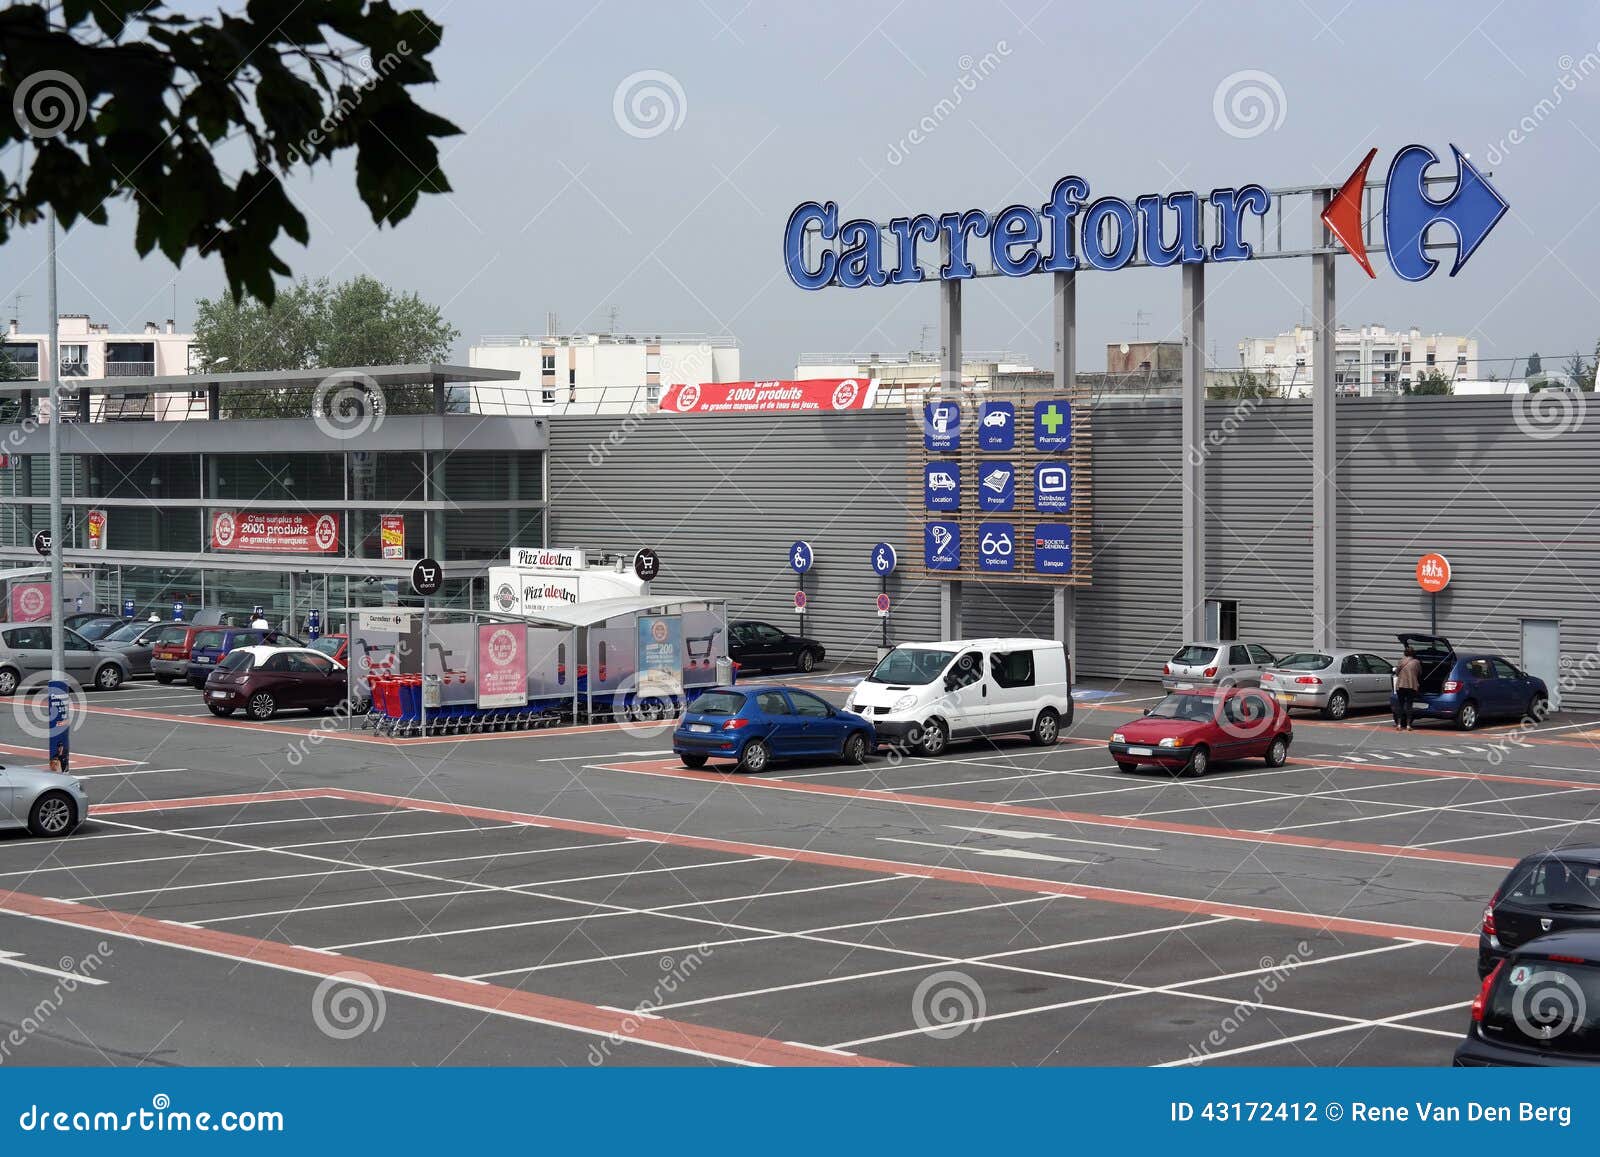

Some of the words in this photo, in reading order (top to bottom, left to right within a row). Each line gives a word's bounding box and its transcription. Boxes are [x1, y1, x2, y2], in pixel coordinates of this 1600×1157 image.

[784, 175, 1271, 290] Carrefour
[757, 387, 803, 402] produits
[709, 403, 733, 411] grandes
[733, 402, 759, 412] marques
[1039, 436, 1067, 444] Pharmacie
[241, 523, 265, 533] 2000
[267, 524, 309, 537] produits
[249, 536, 276, 545] grandes
[1043, 560, 1064, 568] Banque
